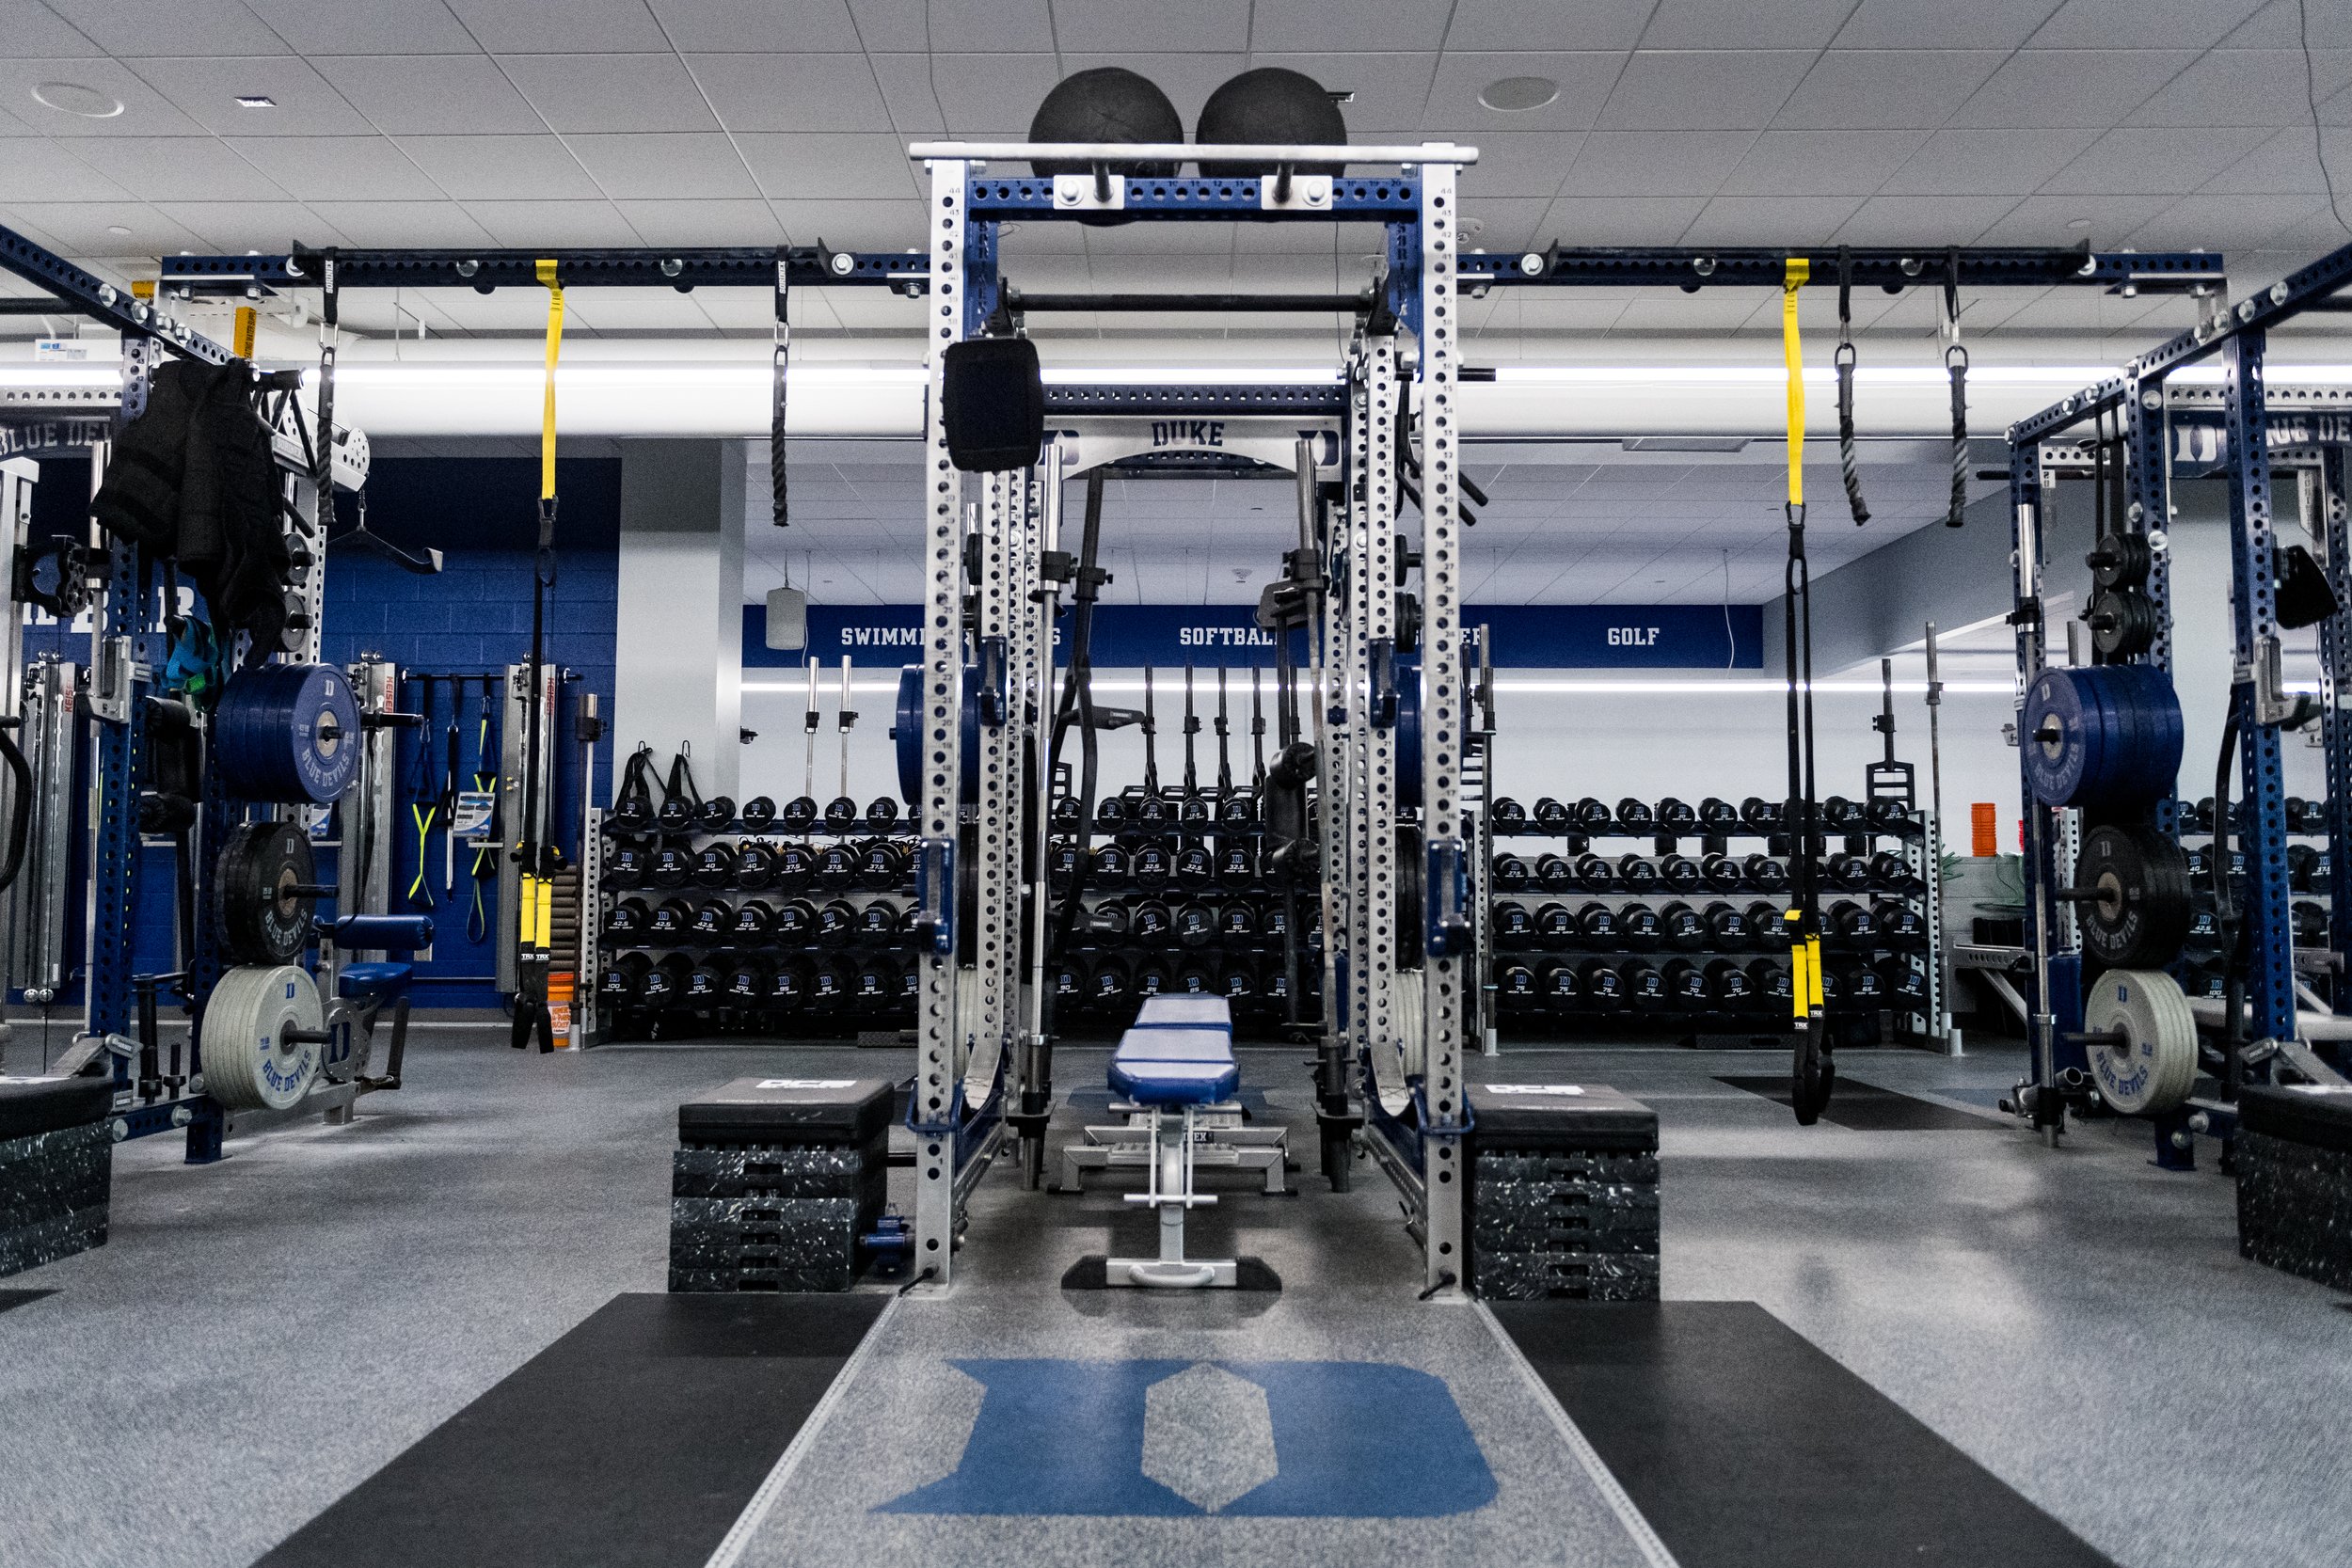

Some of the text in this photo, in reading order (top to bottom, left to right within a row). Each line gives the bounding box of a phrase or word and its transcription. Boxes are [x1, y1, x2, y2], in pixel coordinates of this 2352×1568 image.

[1152, 420, 1224, 446] DUKE
[2174, 424, 2217, 462] D
[841, 627, 925, 646] SWIMMI
[1179, 627, 1278, 646] SOFTBAL
[1607, 627, 1660, 646] GOLF
[325, 680, 334, 697] D
[302, 748, 350, 787] BLUE DEVILS
[286, 838, 294, 854] D
[265, 908, 308, 946] BLUE DEVILS
[2086, 911, 2138, 950] BLUE DEVILS
[286, 982, 295, 999] D
[2118, 985, 2128, 1003] D
[329, 1022, 351, 1065] D
[262, 1050, 312, 1092] BLUE DEVILS
[2097, 1052, 2148, 1096] BLUE DEVILS
[866, 1357, 1499, 1518] D
